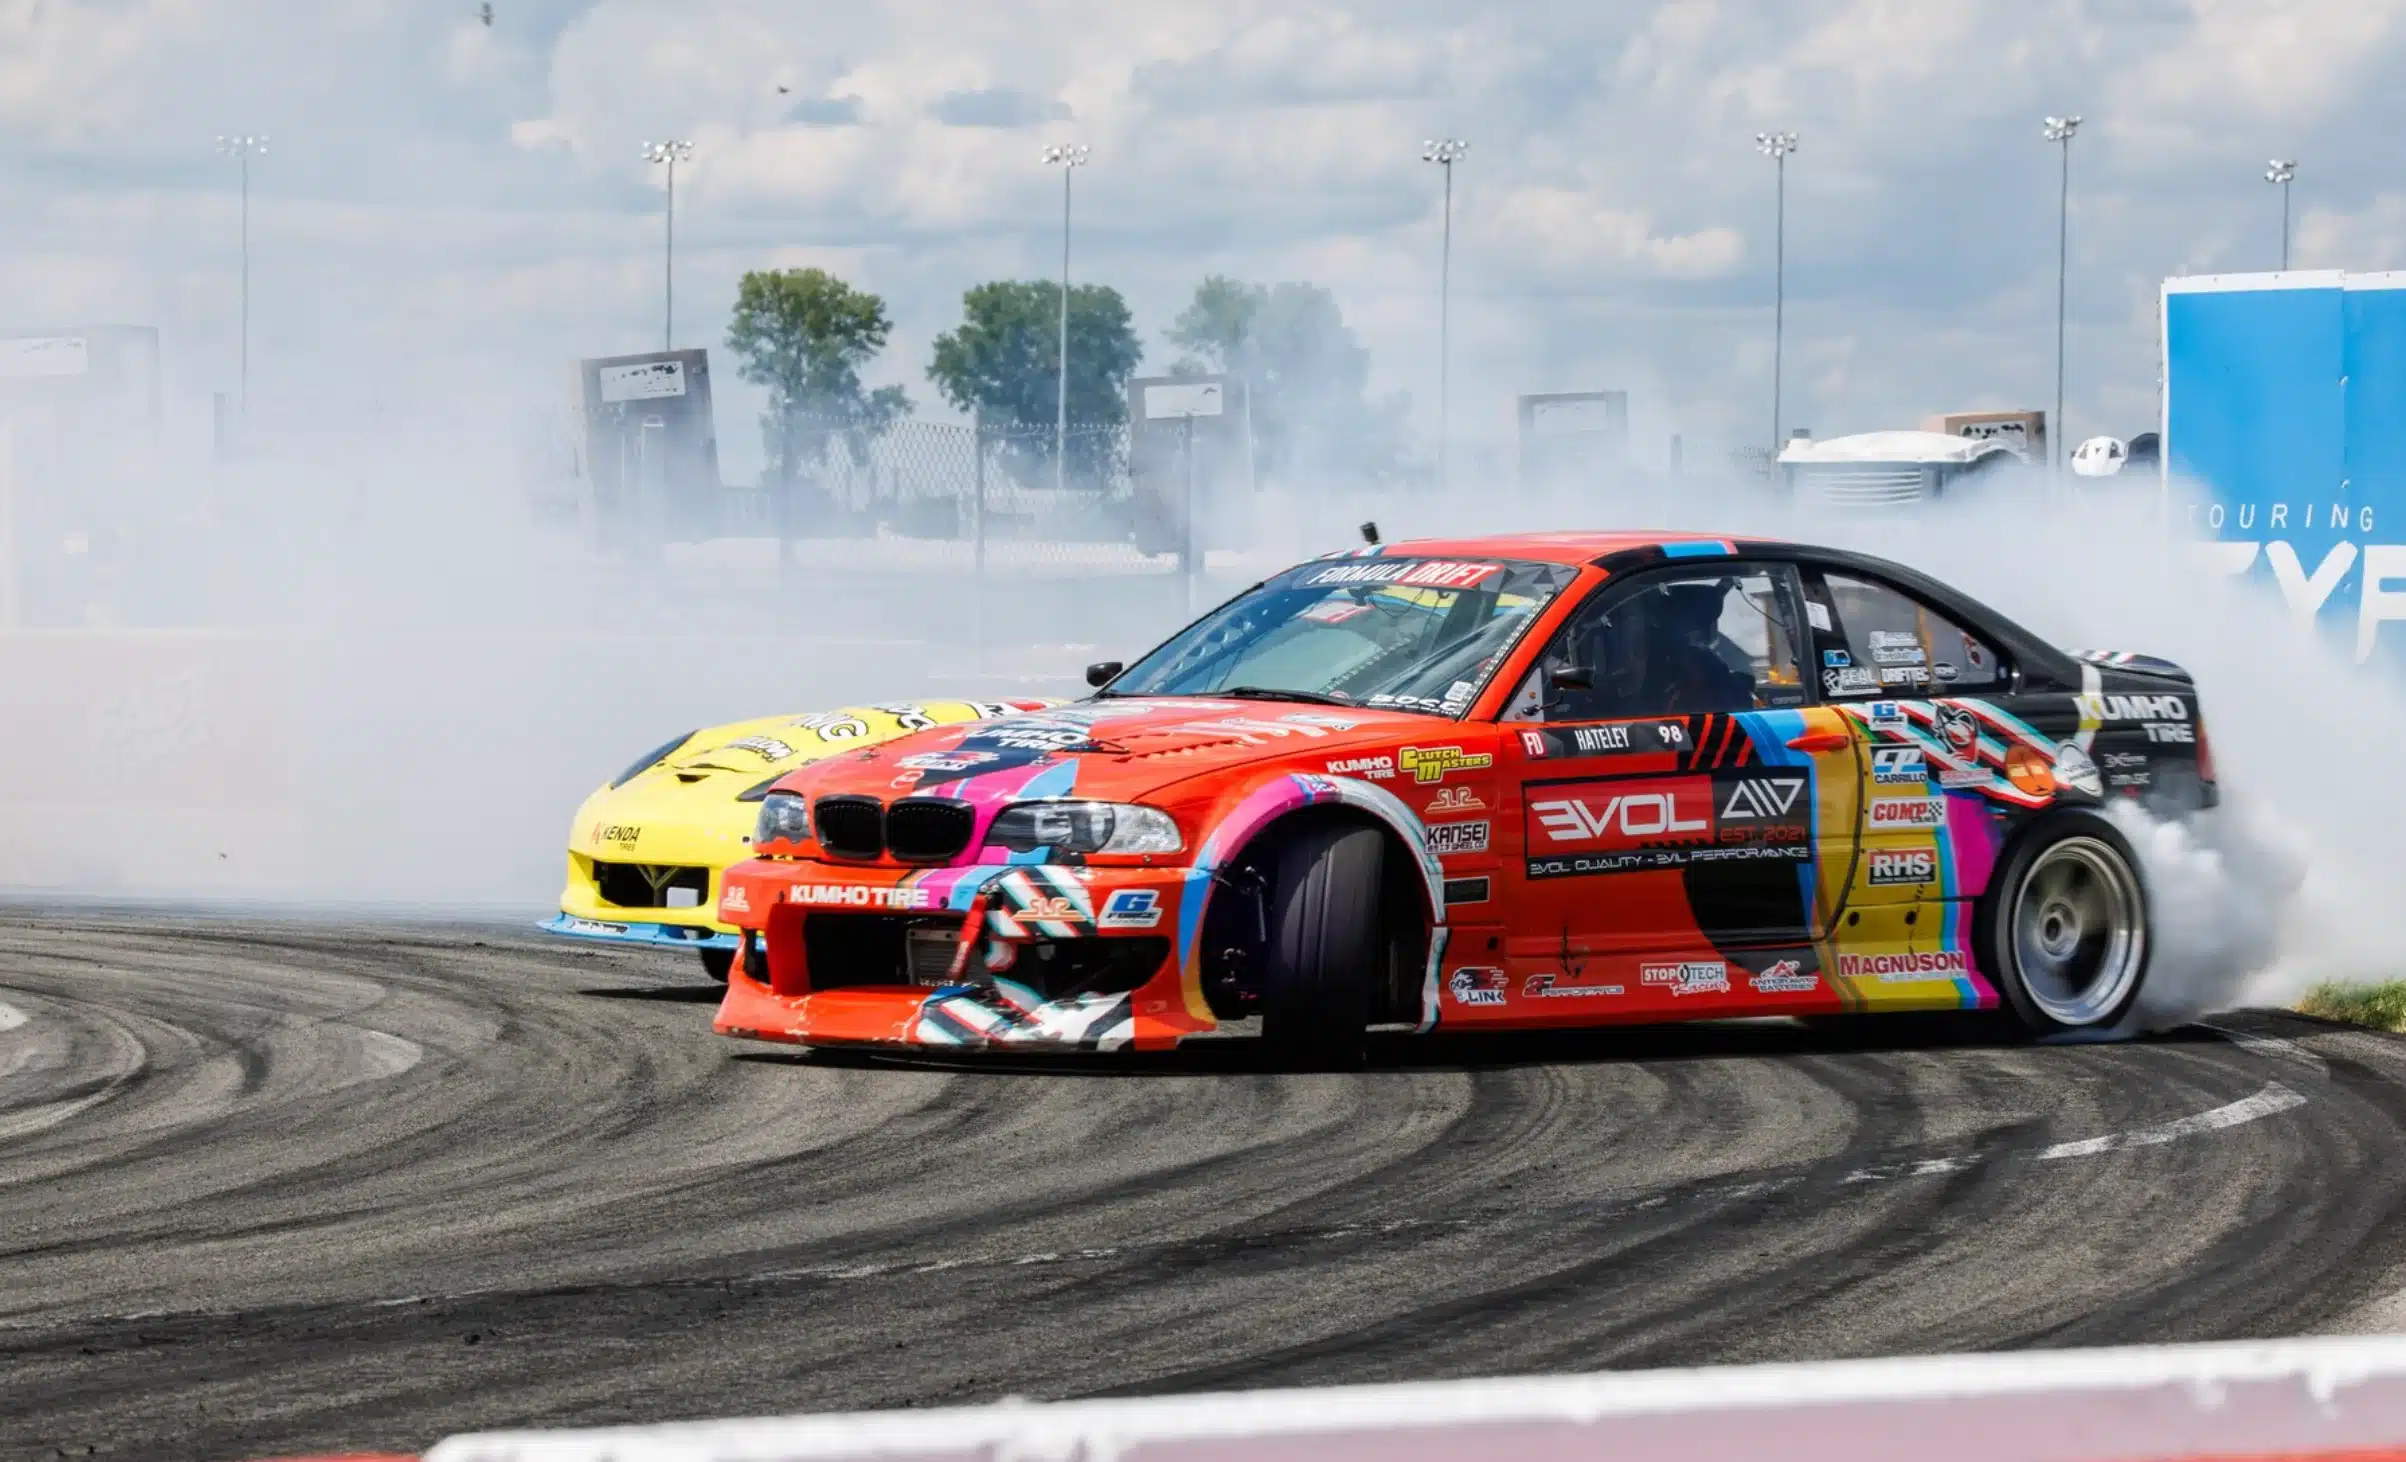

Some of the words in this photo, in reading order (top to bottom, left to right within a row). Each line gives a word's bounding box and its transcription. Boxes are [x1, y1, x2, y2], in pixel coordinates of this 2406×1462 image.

[1306, 564, 1416, 585] FORMULA
[1403, 562, 1498, 587] DRIFT
[2072, 696, 2188, 720] KUMHO
[1522, 731, 1544, 755] FD
[1574, 727, 1630, 750] HATELEY
[1658, 725, 1683, 743] 98
[2141, 723, 2195, 742] TIRE
[1326, 756, 1393, 773] KUMHO
[1401, 749, 1460, 770] CLUTCH
[1417, 755, 1491, 781] MASTERS
[1364, 769, 1395, 780] TIRE
[1875, 773, 1928, 784] CARRILLO
[1873, 802, 1930, 822] COMP
[602, 824, 641, 843] KENDA
[1427, 823, 1488, 846] KANSEI
[1575, 856, 1643, 872] QUALITY
[1690, 847, 1809, 862] PERFORMANCE
[1873, 852, 1933, 877] RHS
[789, 884, 869, 904] KUMHO
[870, 887, 930, 906] TIRE
[1839, 951, 1965, 977] MAGNUSON
